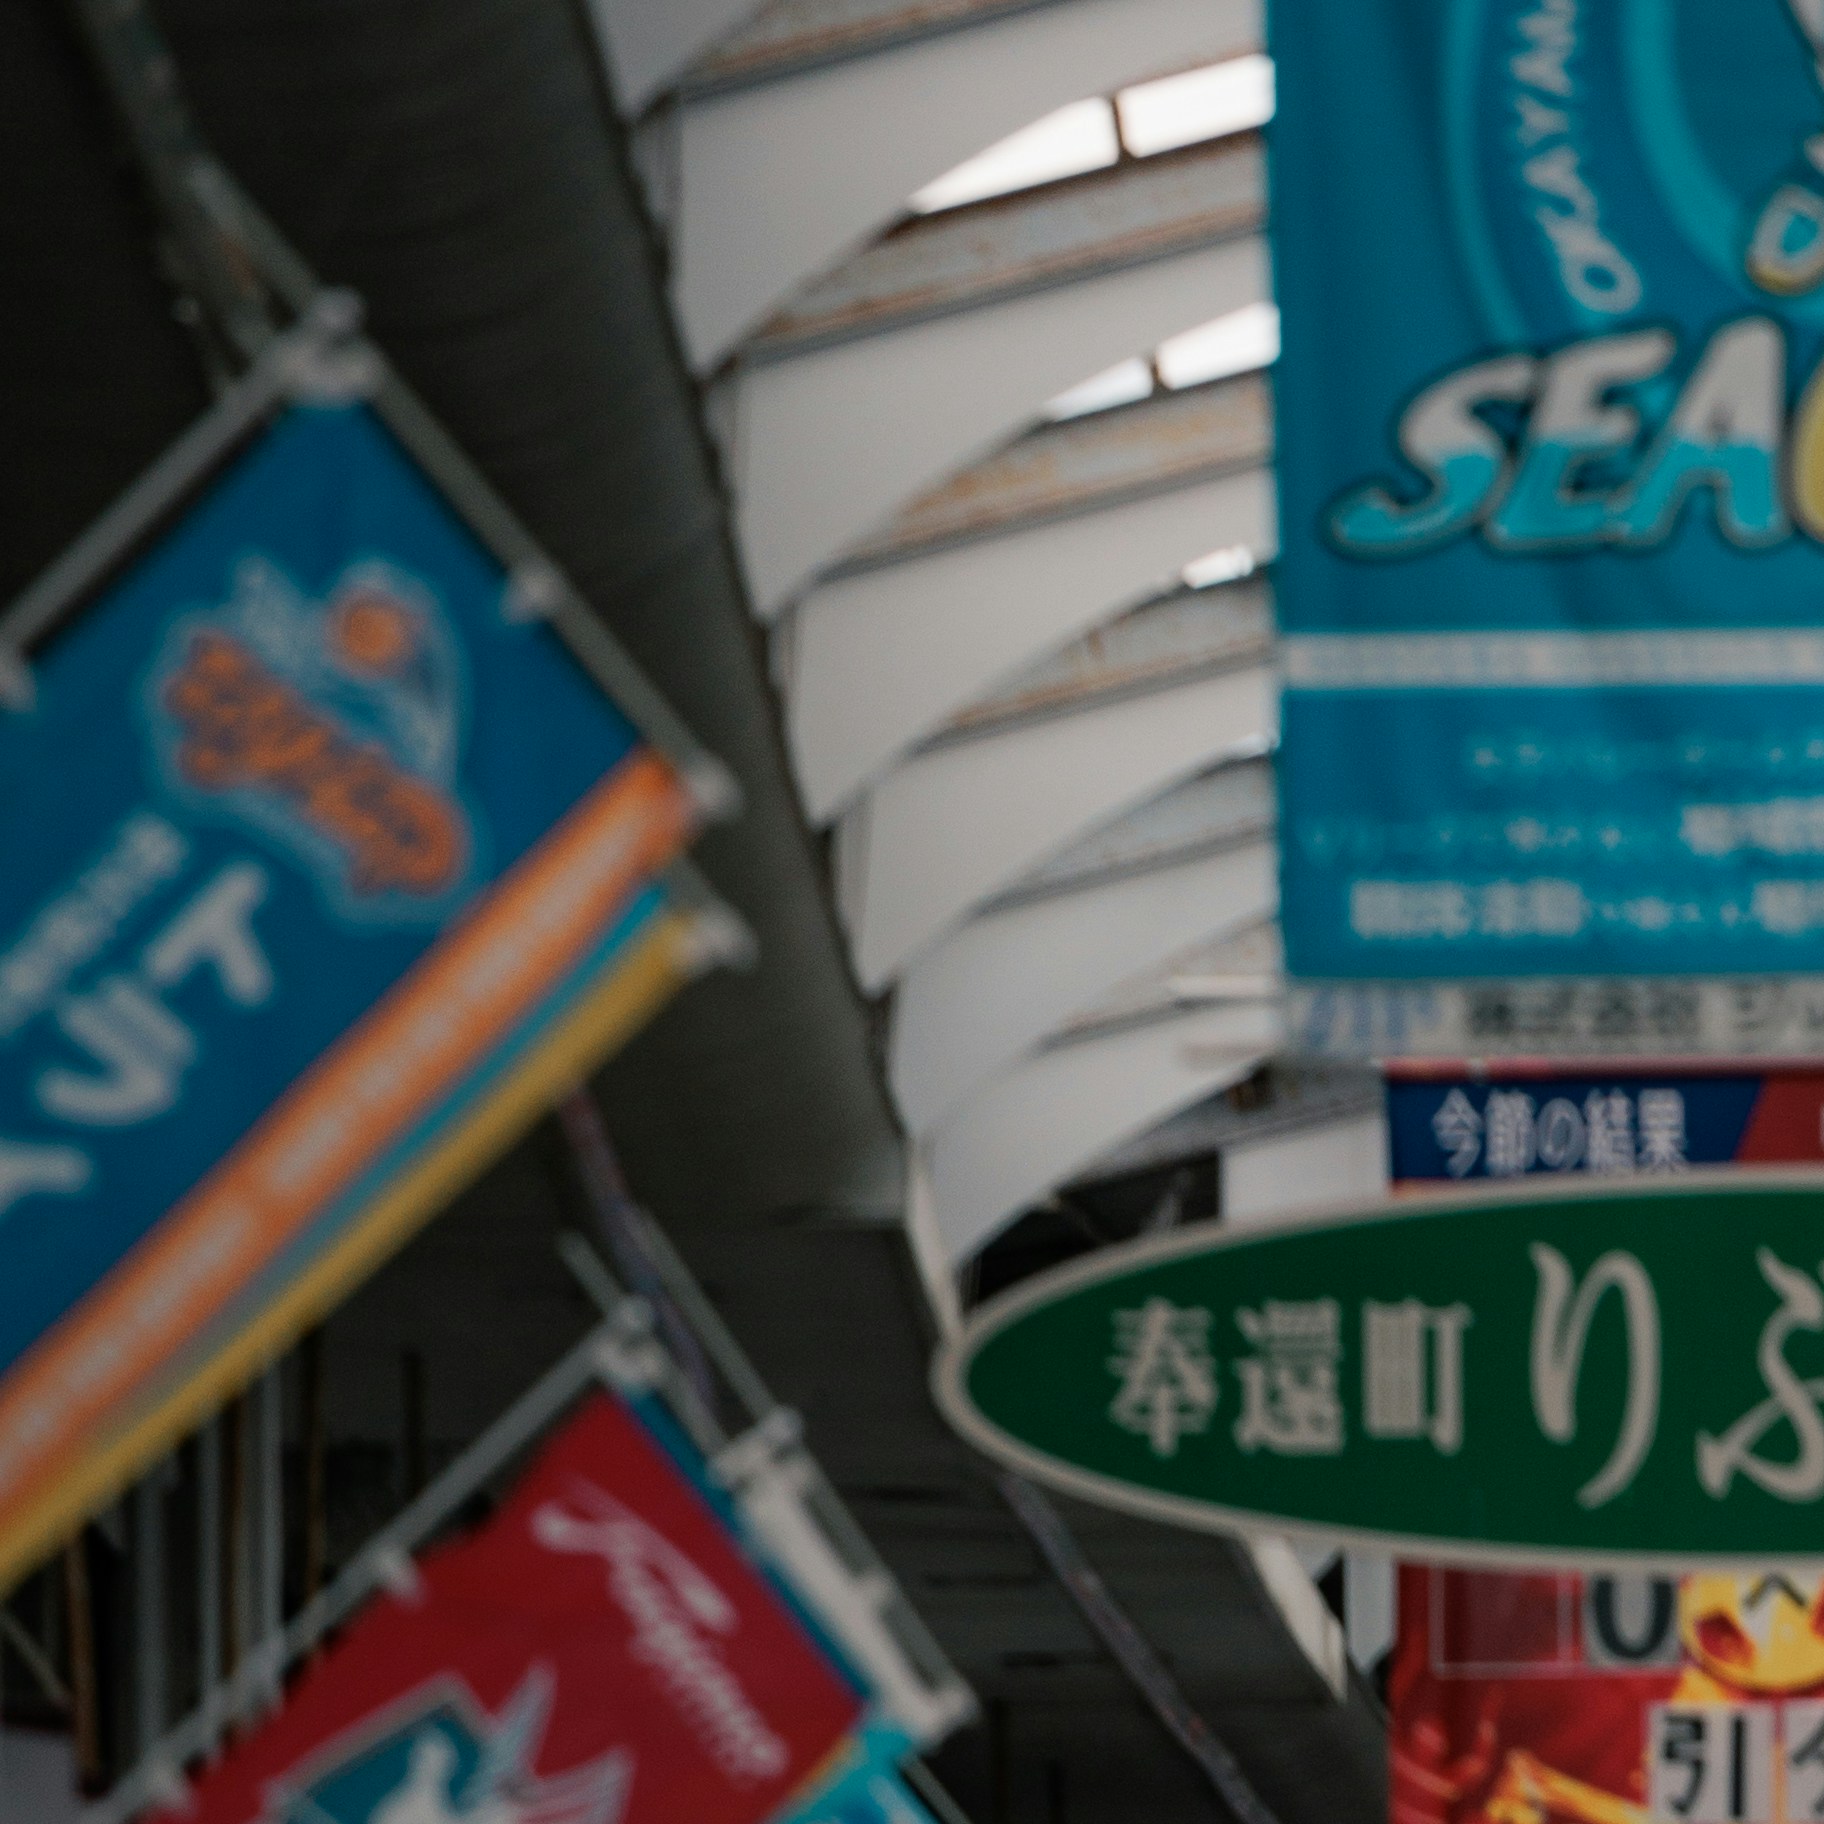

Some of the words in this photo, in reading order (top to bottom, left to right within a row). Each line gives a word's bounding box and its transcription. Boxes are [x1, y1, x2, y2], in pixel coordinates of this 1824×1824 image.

[1432, 1086, 1686, 1180] 今節の結果
[1108, 1298, 1470, 1460] 奉還町
